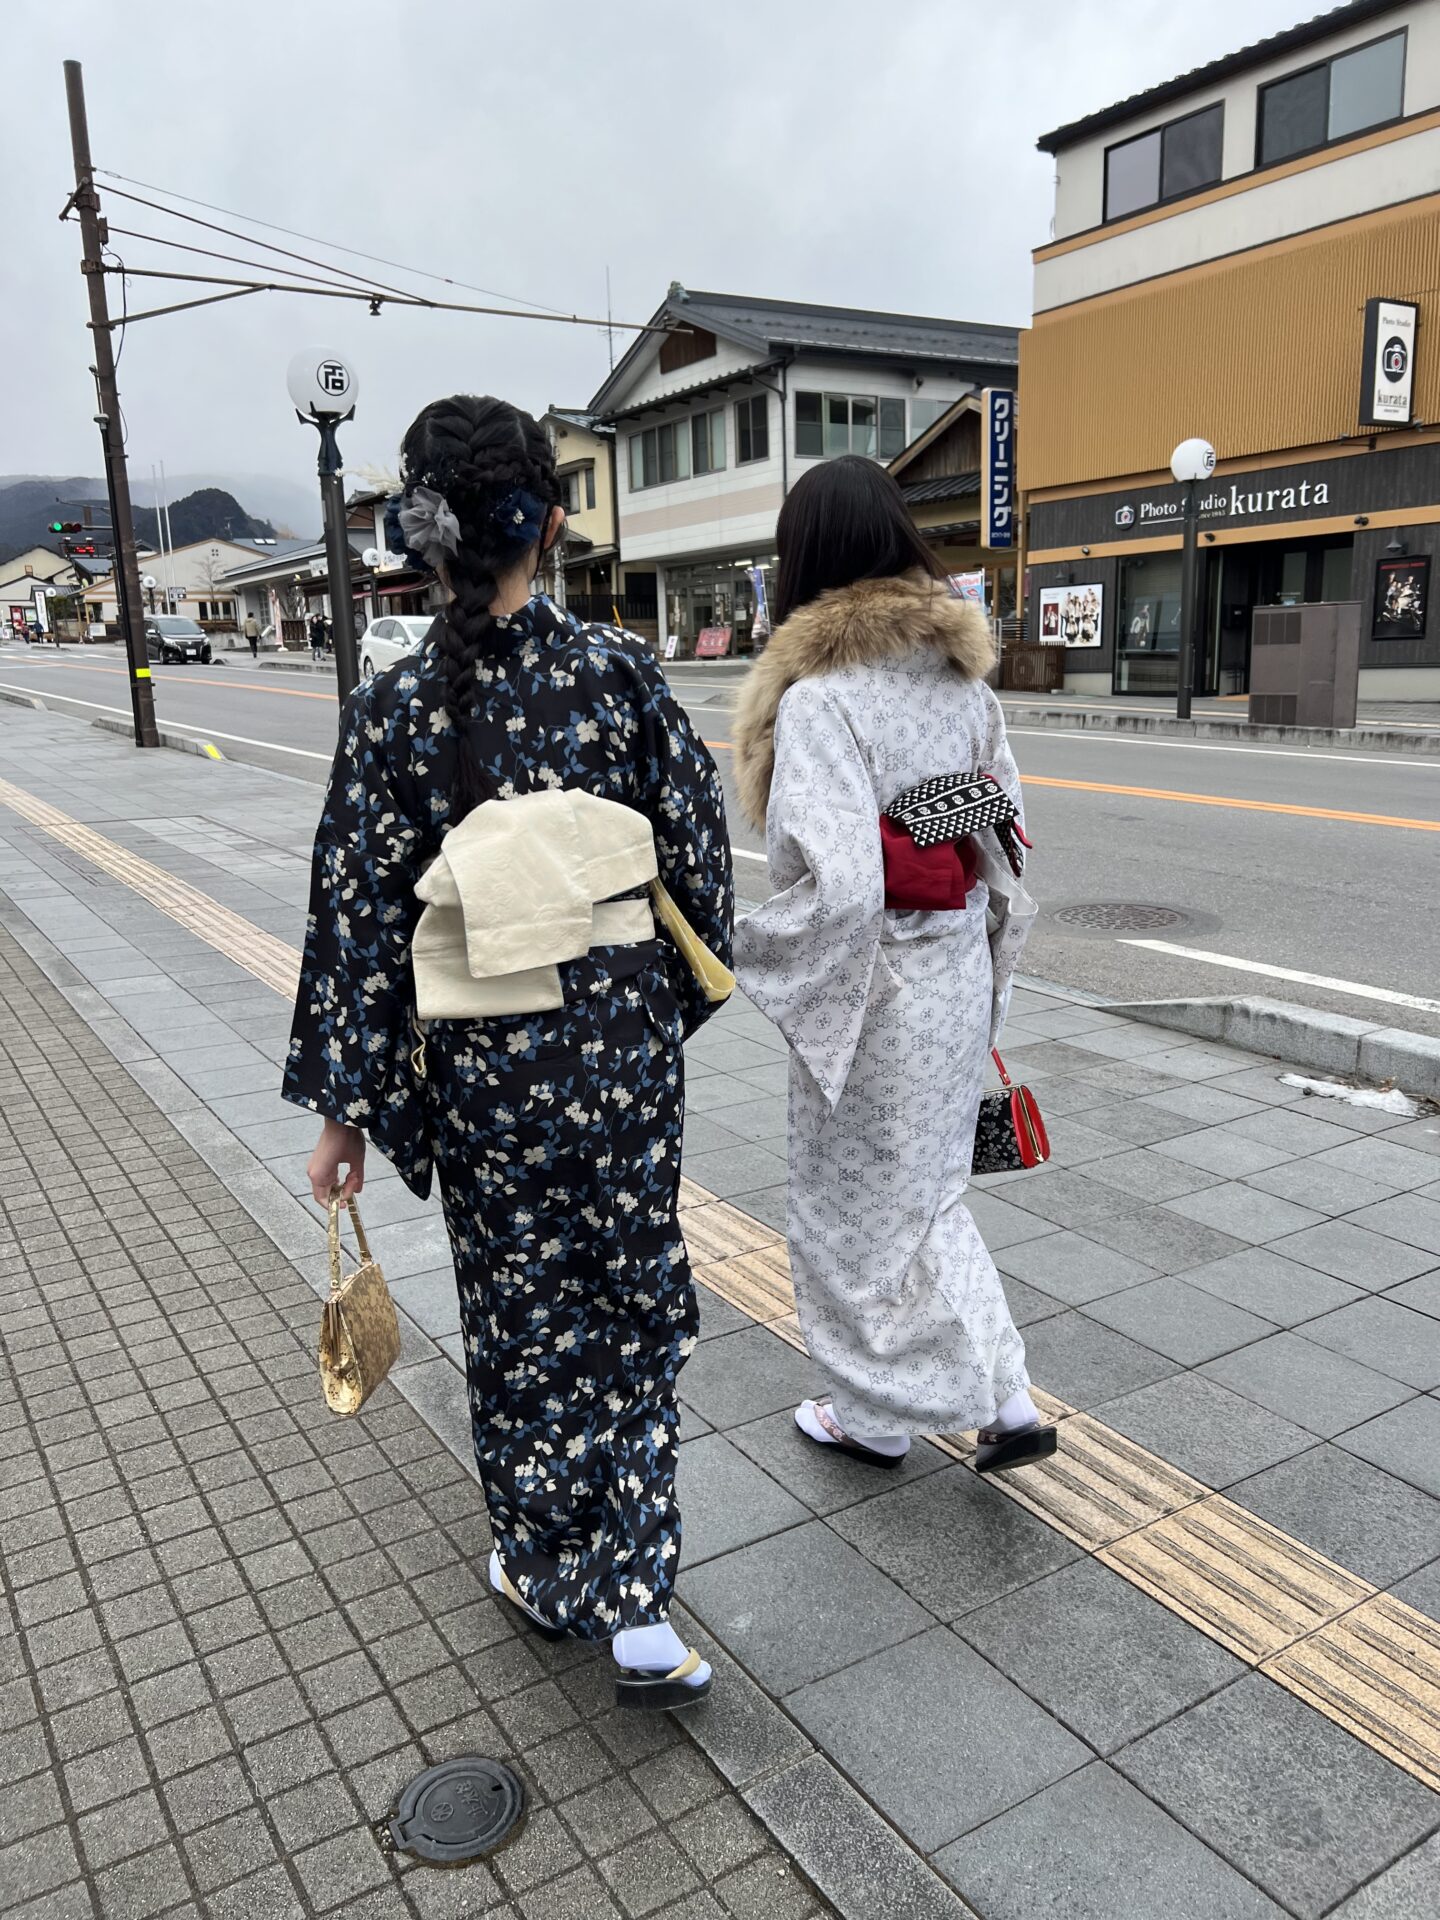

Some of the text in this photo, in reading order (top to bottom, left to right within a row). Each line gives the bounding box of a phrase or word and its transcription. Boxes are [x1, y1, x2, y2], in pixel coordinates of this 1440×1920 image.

[1377, 388, 1408, 406] kurata
[994, 398, 1011, 527] クリーニング
[1140, 502, 1177, 518] Photo
[1229, 480, 1329, 515] kurata
